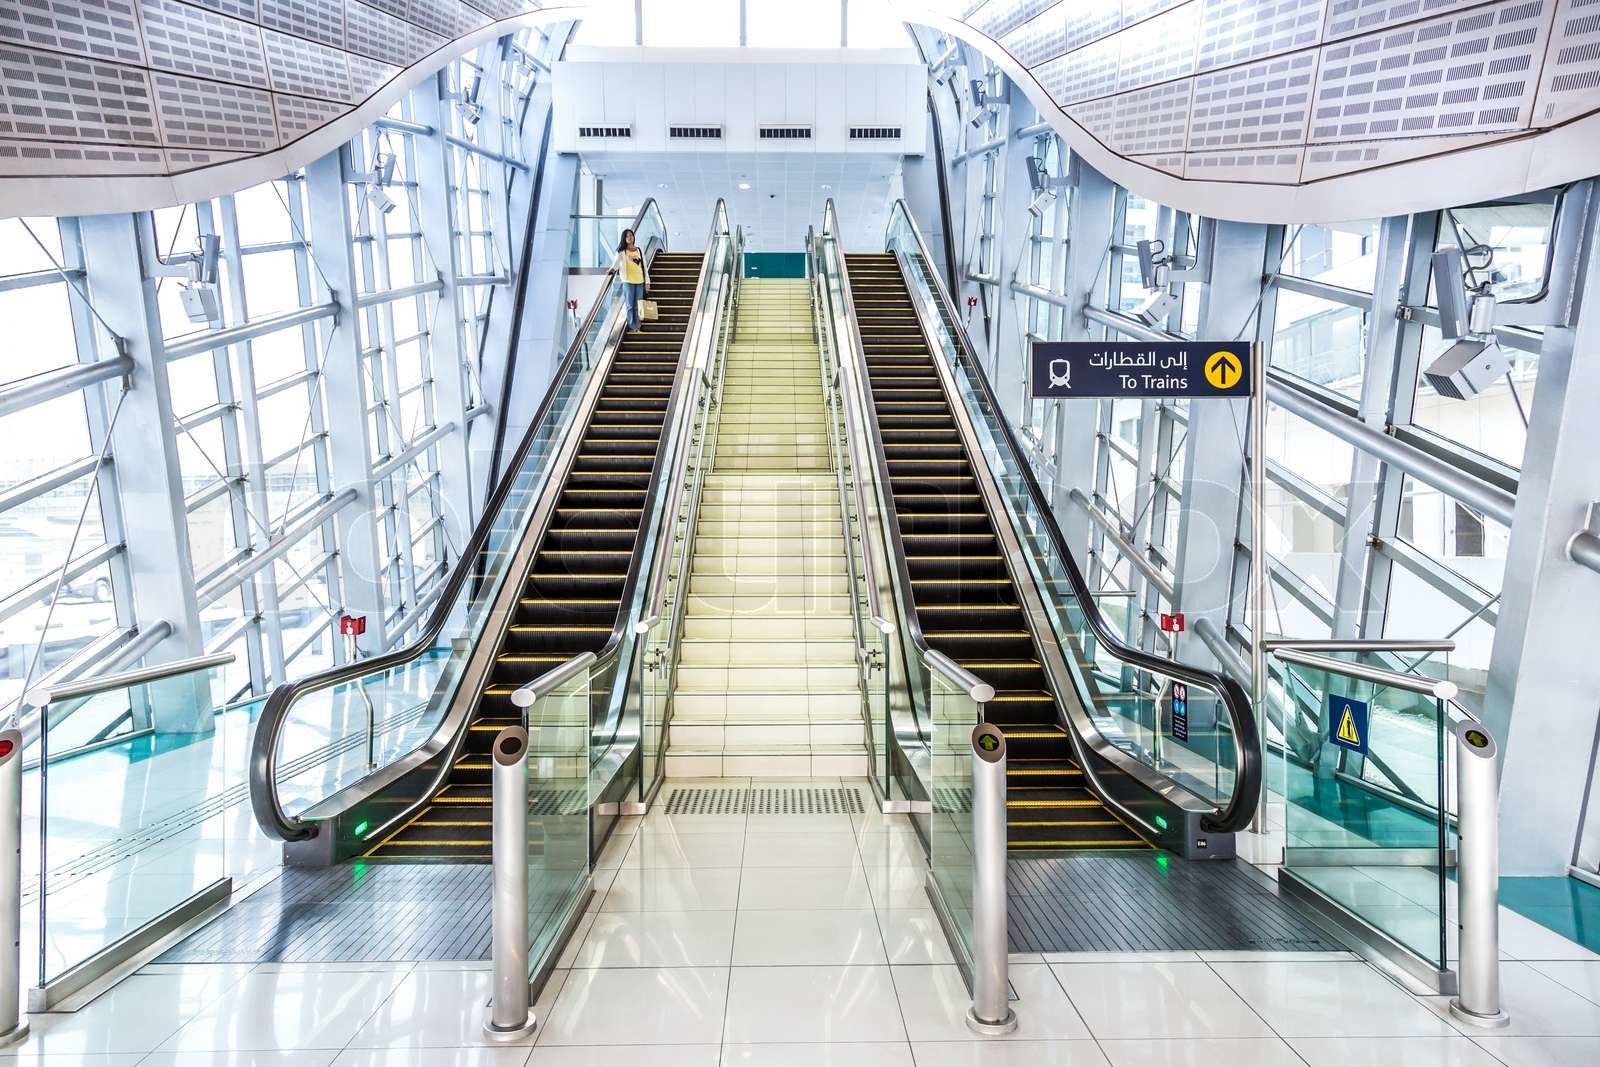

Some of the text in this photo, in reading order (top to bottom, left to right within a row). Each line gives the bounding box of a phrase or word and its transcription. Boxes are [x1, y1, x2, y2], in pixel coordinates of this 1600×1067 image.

[1089, 351, 1188, 370] إلى القطارات
[1118, 374, 1188, 389] To Trains
